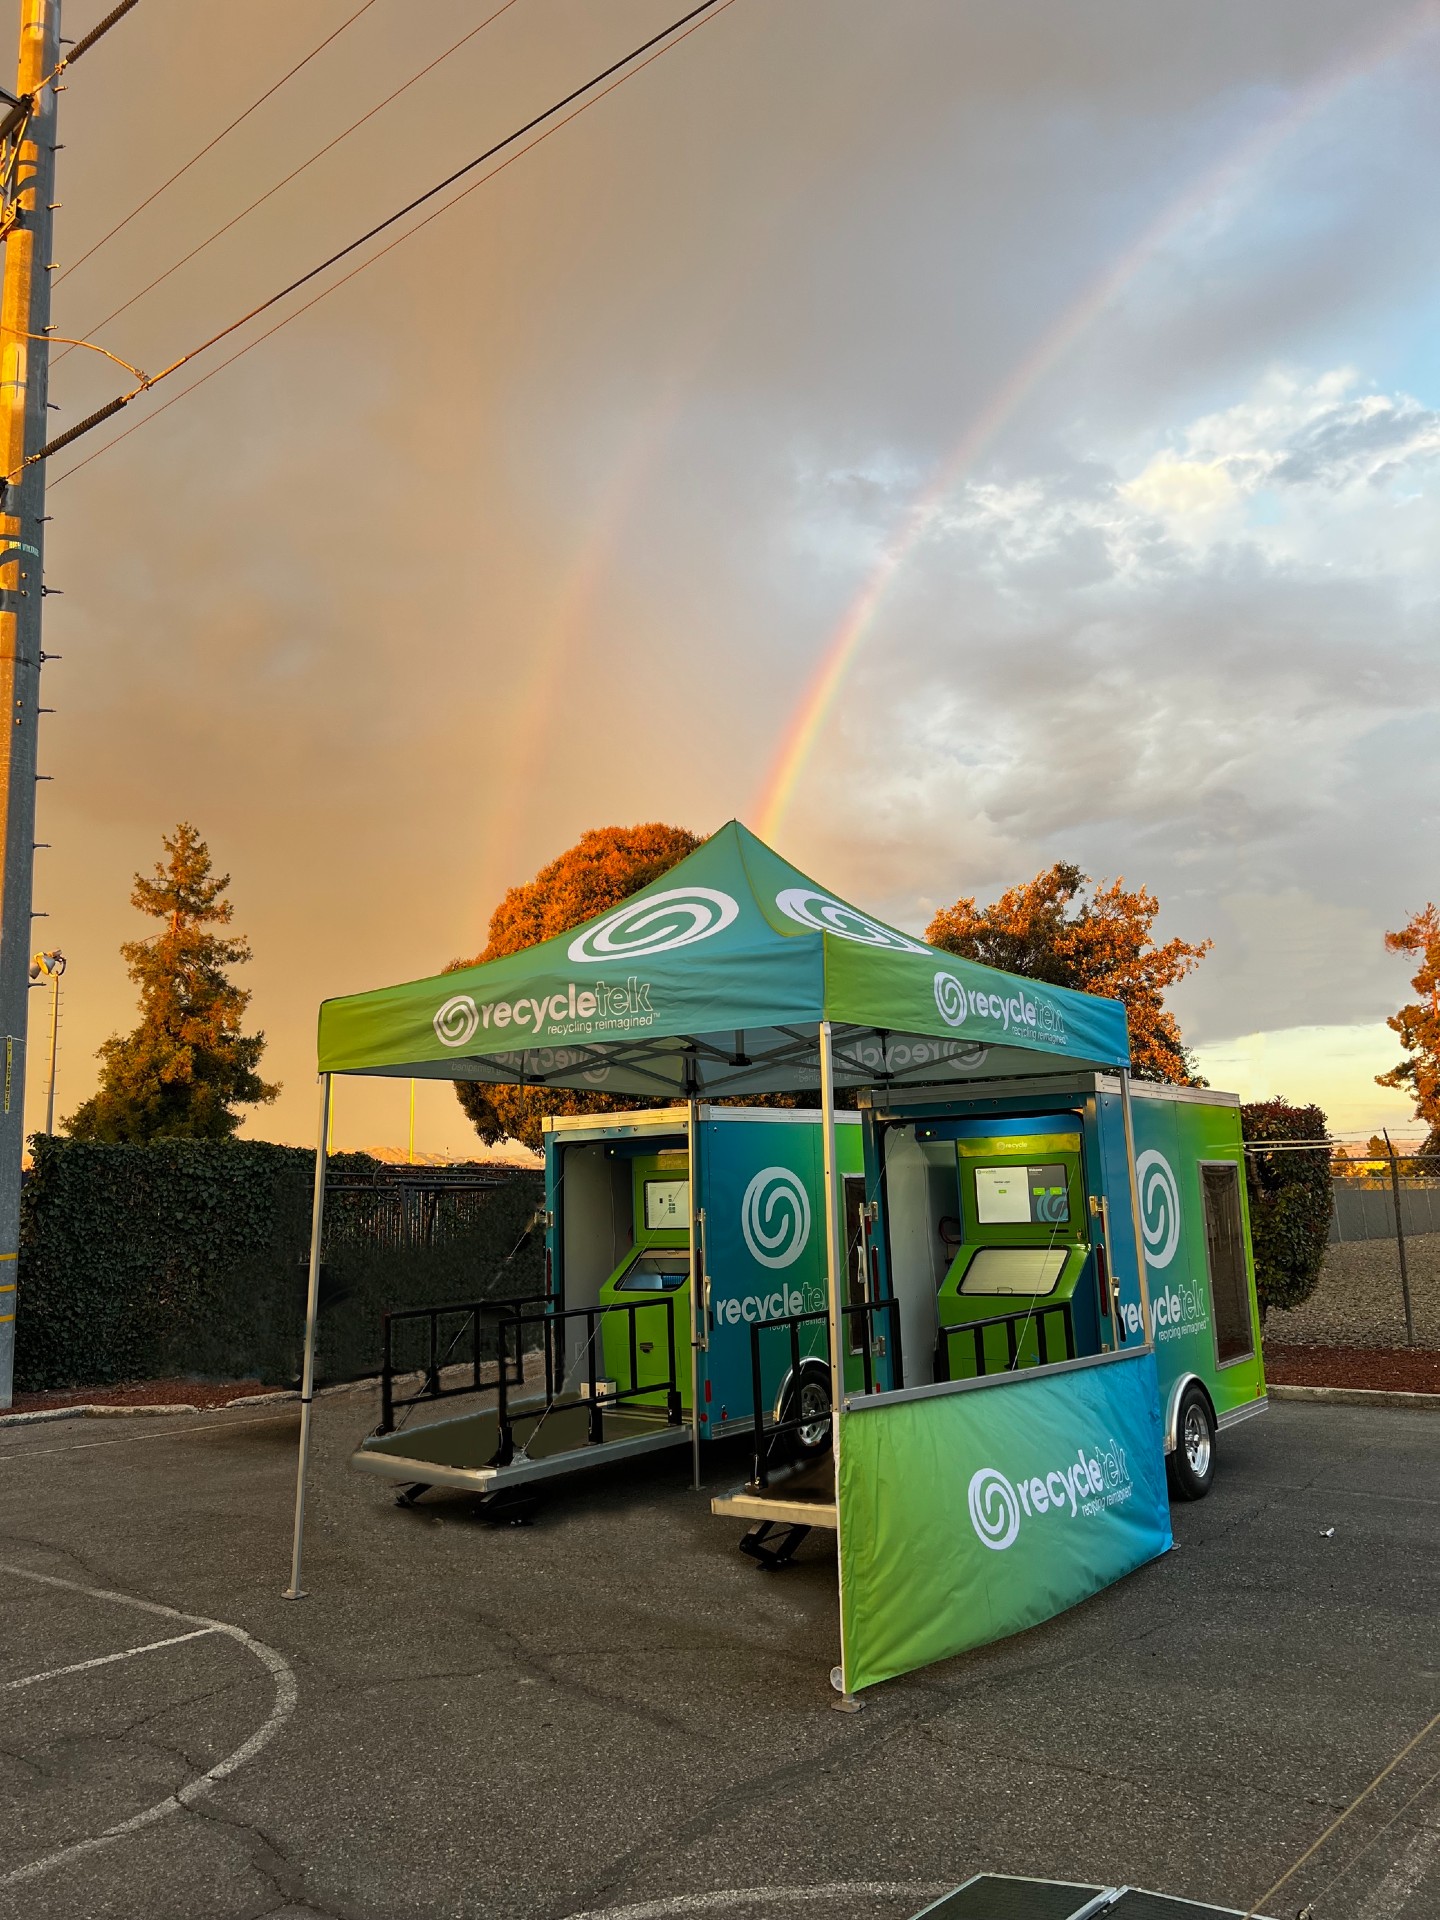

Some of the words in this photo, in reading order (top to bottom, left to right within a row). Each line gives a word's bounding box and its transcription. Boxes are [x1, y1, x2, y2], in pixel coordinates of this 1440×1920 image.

[482, 976, 653, 1033] recycletek
[967, 989, 1064, 1033] recycletek
[547, 1020, 592, 1035] recycling
[1011, 1026, 1037, 1041] recycling
[1158, 1326, 1181, 1342] recycling
[1016, 1438, 1130, 1518] recycletek
[1081, 1496, 1105, 1517] recycling
